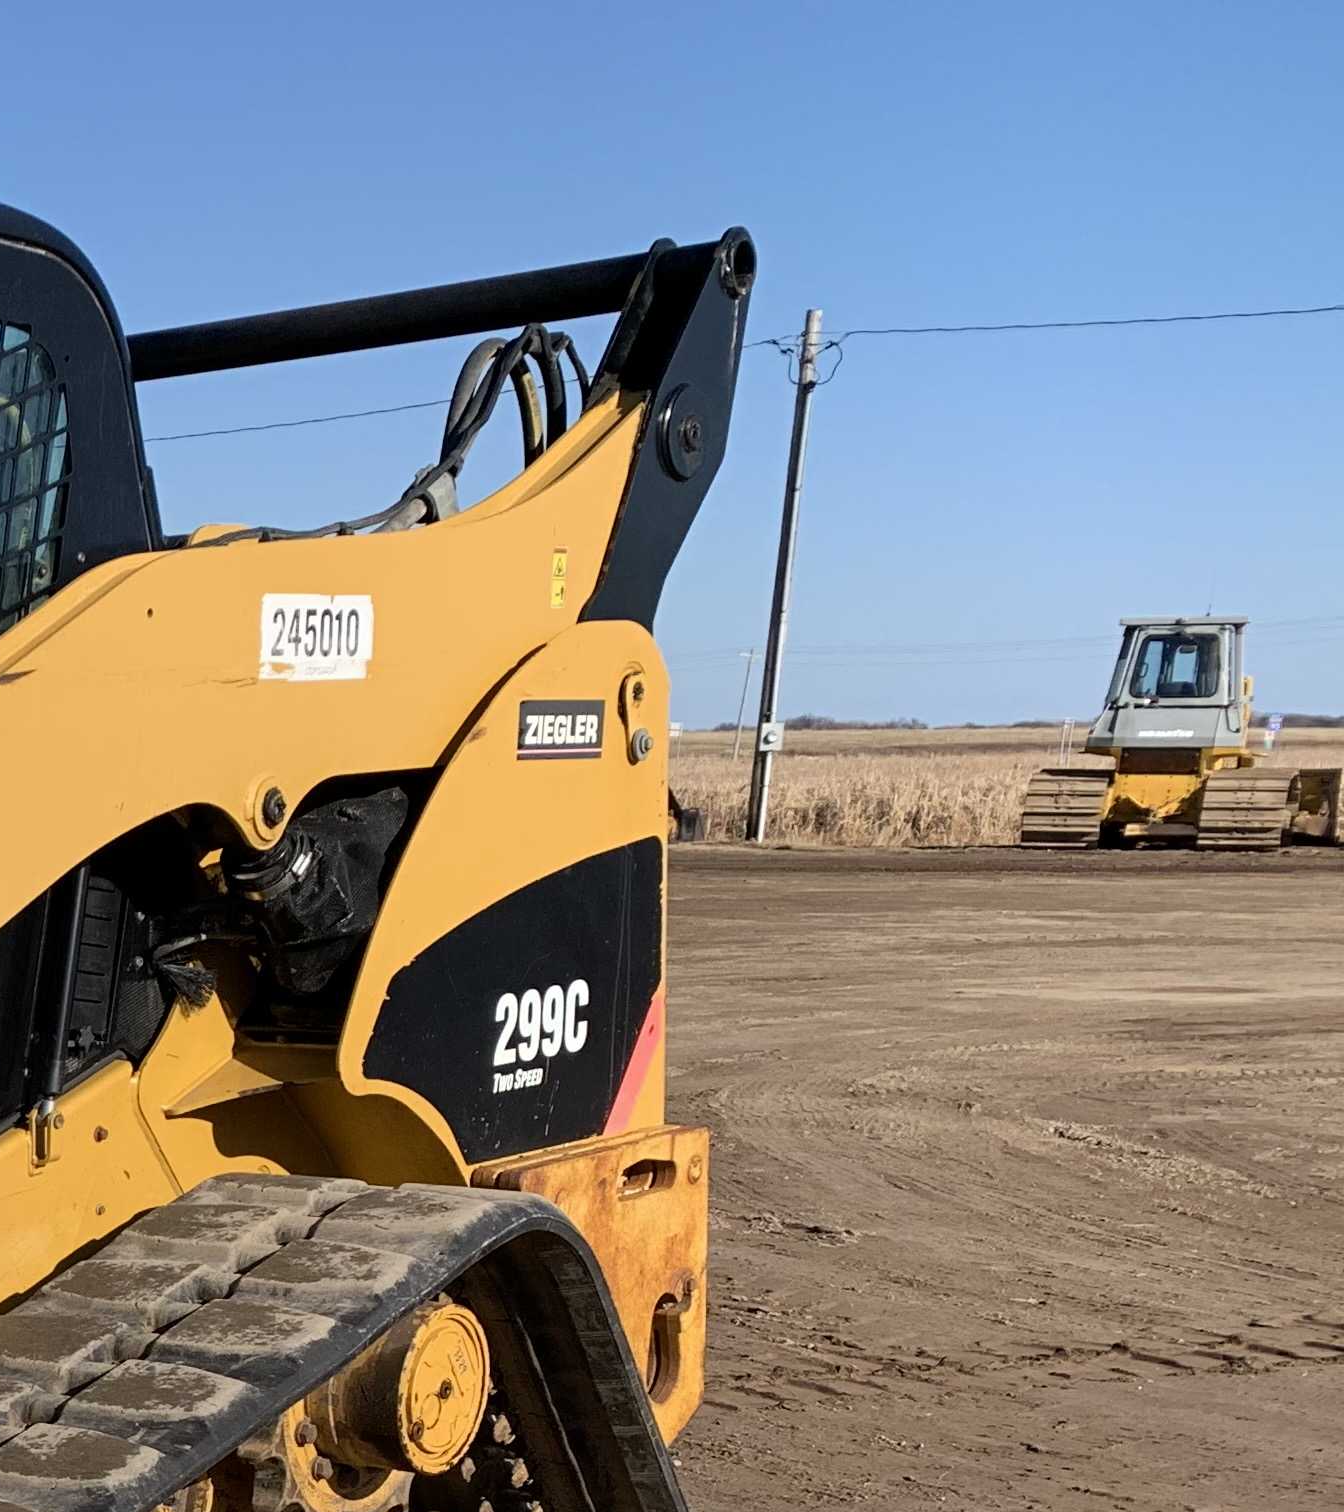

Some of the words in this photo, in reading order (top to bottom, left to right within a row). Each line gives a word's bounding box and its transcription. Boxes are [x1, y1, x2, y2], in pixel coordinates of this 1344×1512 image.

[270, 607, 360, 657] 245010
[524, 714, 599, 745] ZIEGLER
[493, 979, 590, 1067] 299C
